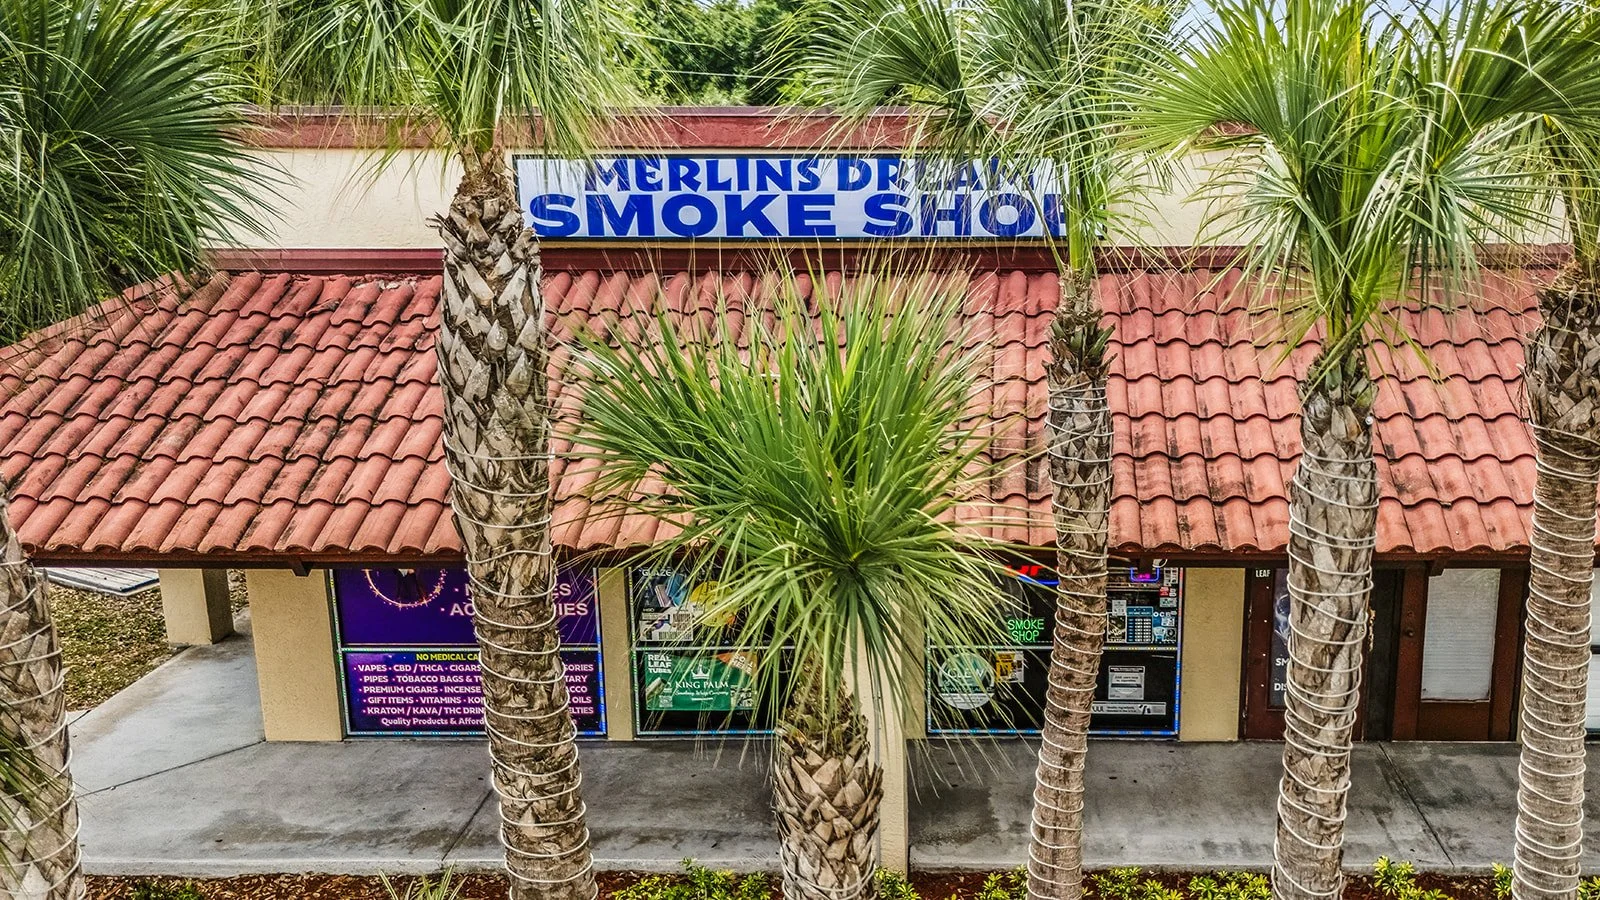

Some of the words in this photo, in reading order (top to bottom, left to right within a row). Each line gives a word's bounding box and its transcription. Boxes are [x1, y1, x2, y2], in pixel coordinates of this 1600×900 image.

[585, 158, 821, 192] MERLINS
[530, 194, 837, 237] SMOKE
[1008, 619, 1045, 630] SMOKE
[1012, 630, 1040, 642] SHOP
[363, 686, 405, 694] PREMIUM
[675, 681, 700, 689] KING
[703, 681, 729, 689] PALM
[381, 718, 411, 726] Quality
